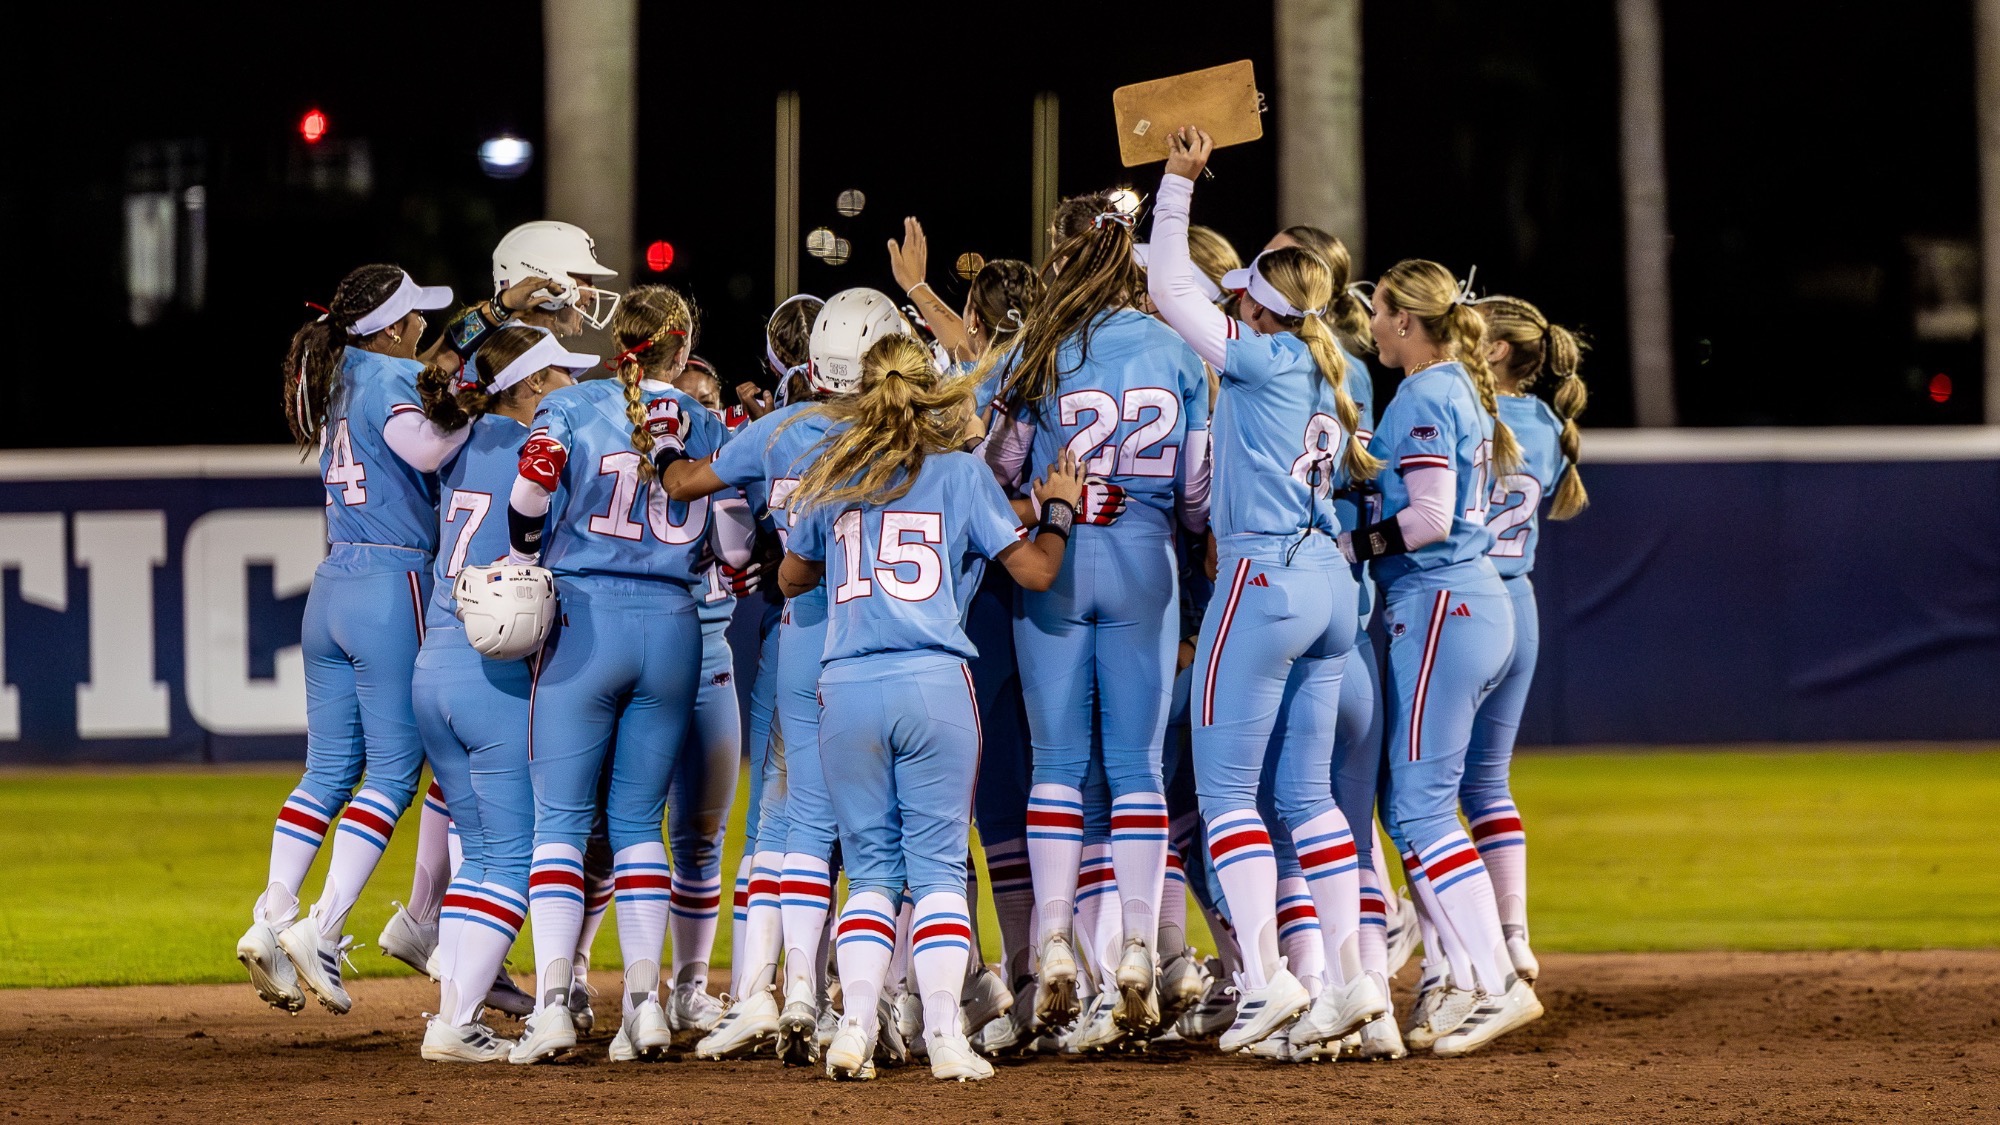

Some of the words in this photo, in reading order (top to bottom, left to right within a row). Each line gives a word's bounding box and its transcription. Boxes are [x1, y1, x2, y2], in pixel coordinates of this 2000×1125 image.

[319, 417, 367, 507] 4
[1058, 387, 1179, 478] 22
[1289, 412, 1342, 501] 8
[445, 488, 493, 579] 7
[588, 450, 711, 546] 10
[833, 507, 943, 605] 15
